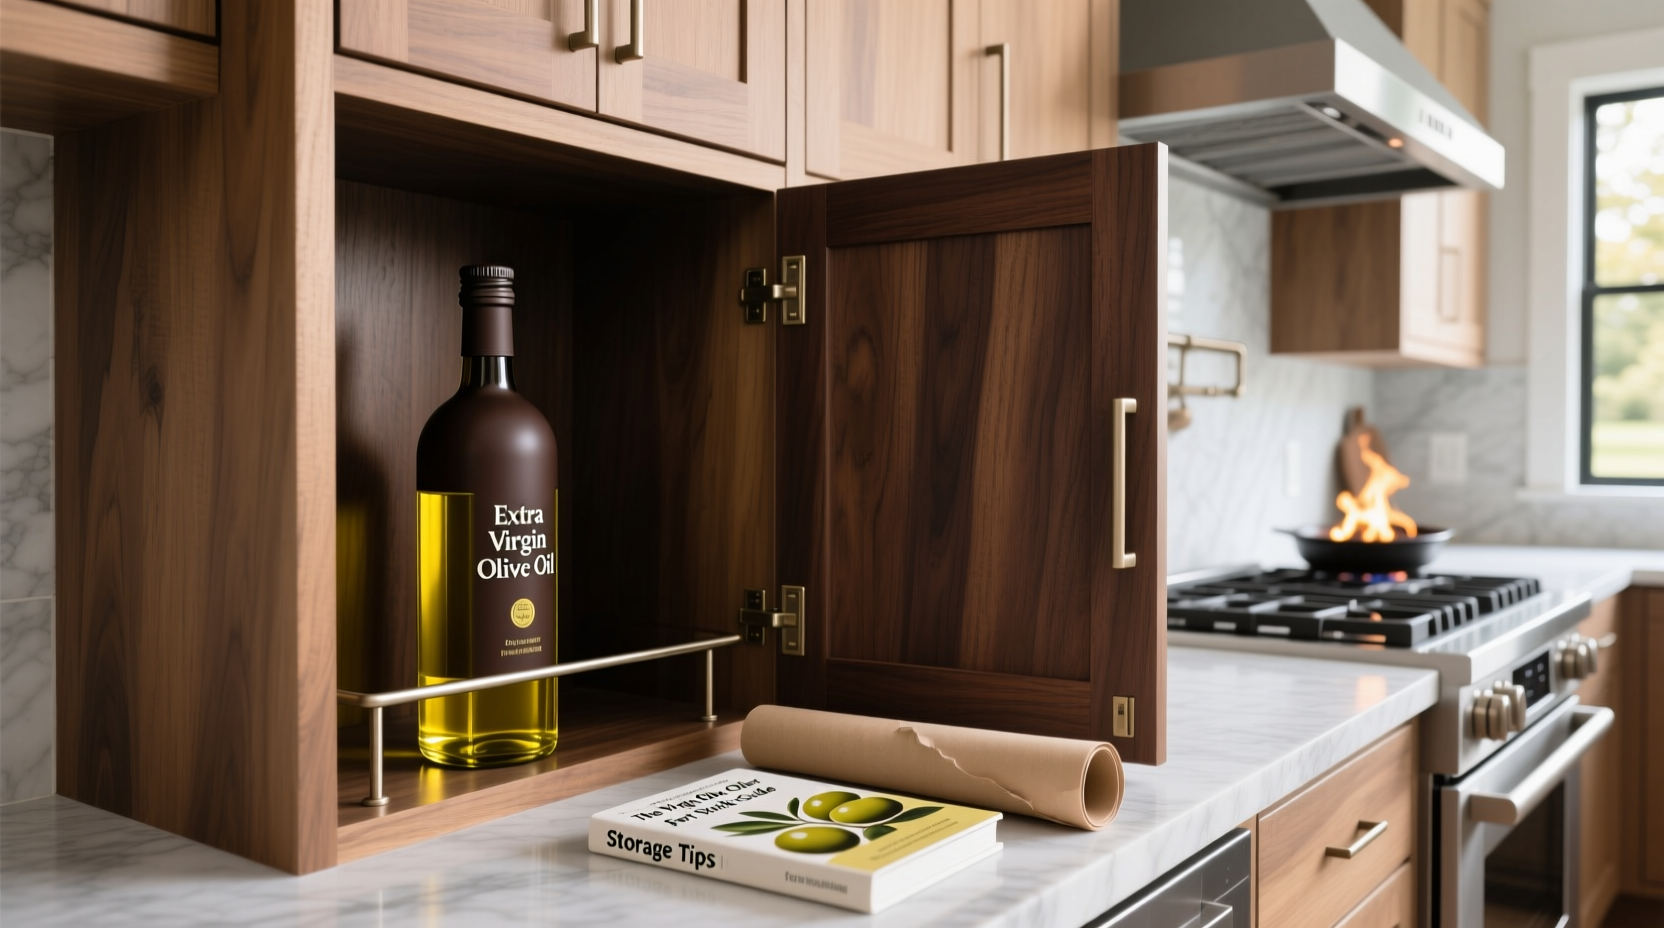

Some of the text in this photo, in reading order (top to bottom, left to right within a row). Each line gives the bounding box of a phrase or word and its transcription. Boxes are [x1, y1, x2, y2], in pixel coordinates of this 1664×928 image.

[494, 504, 544, 526] Extra
[488, 529, 547, 557] Virgin
[477, 552, 554, 580] Olive Oil
[606, 829, 716, 870] Storage Tips
